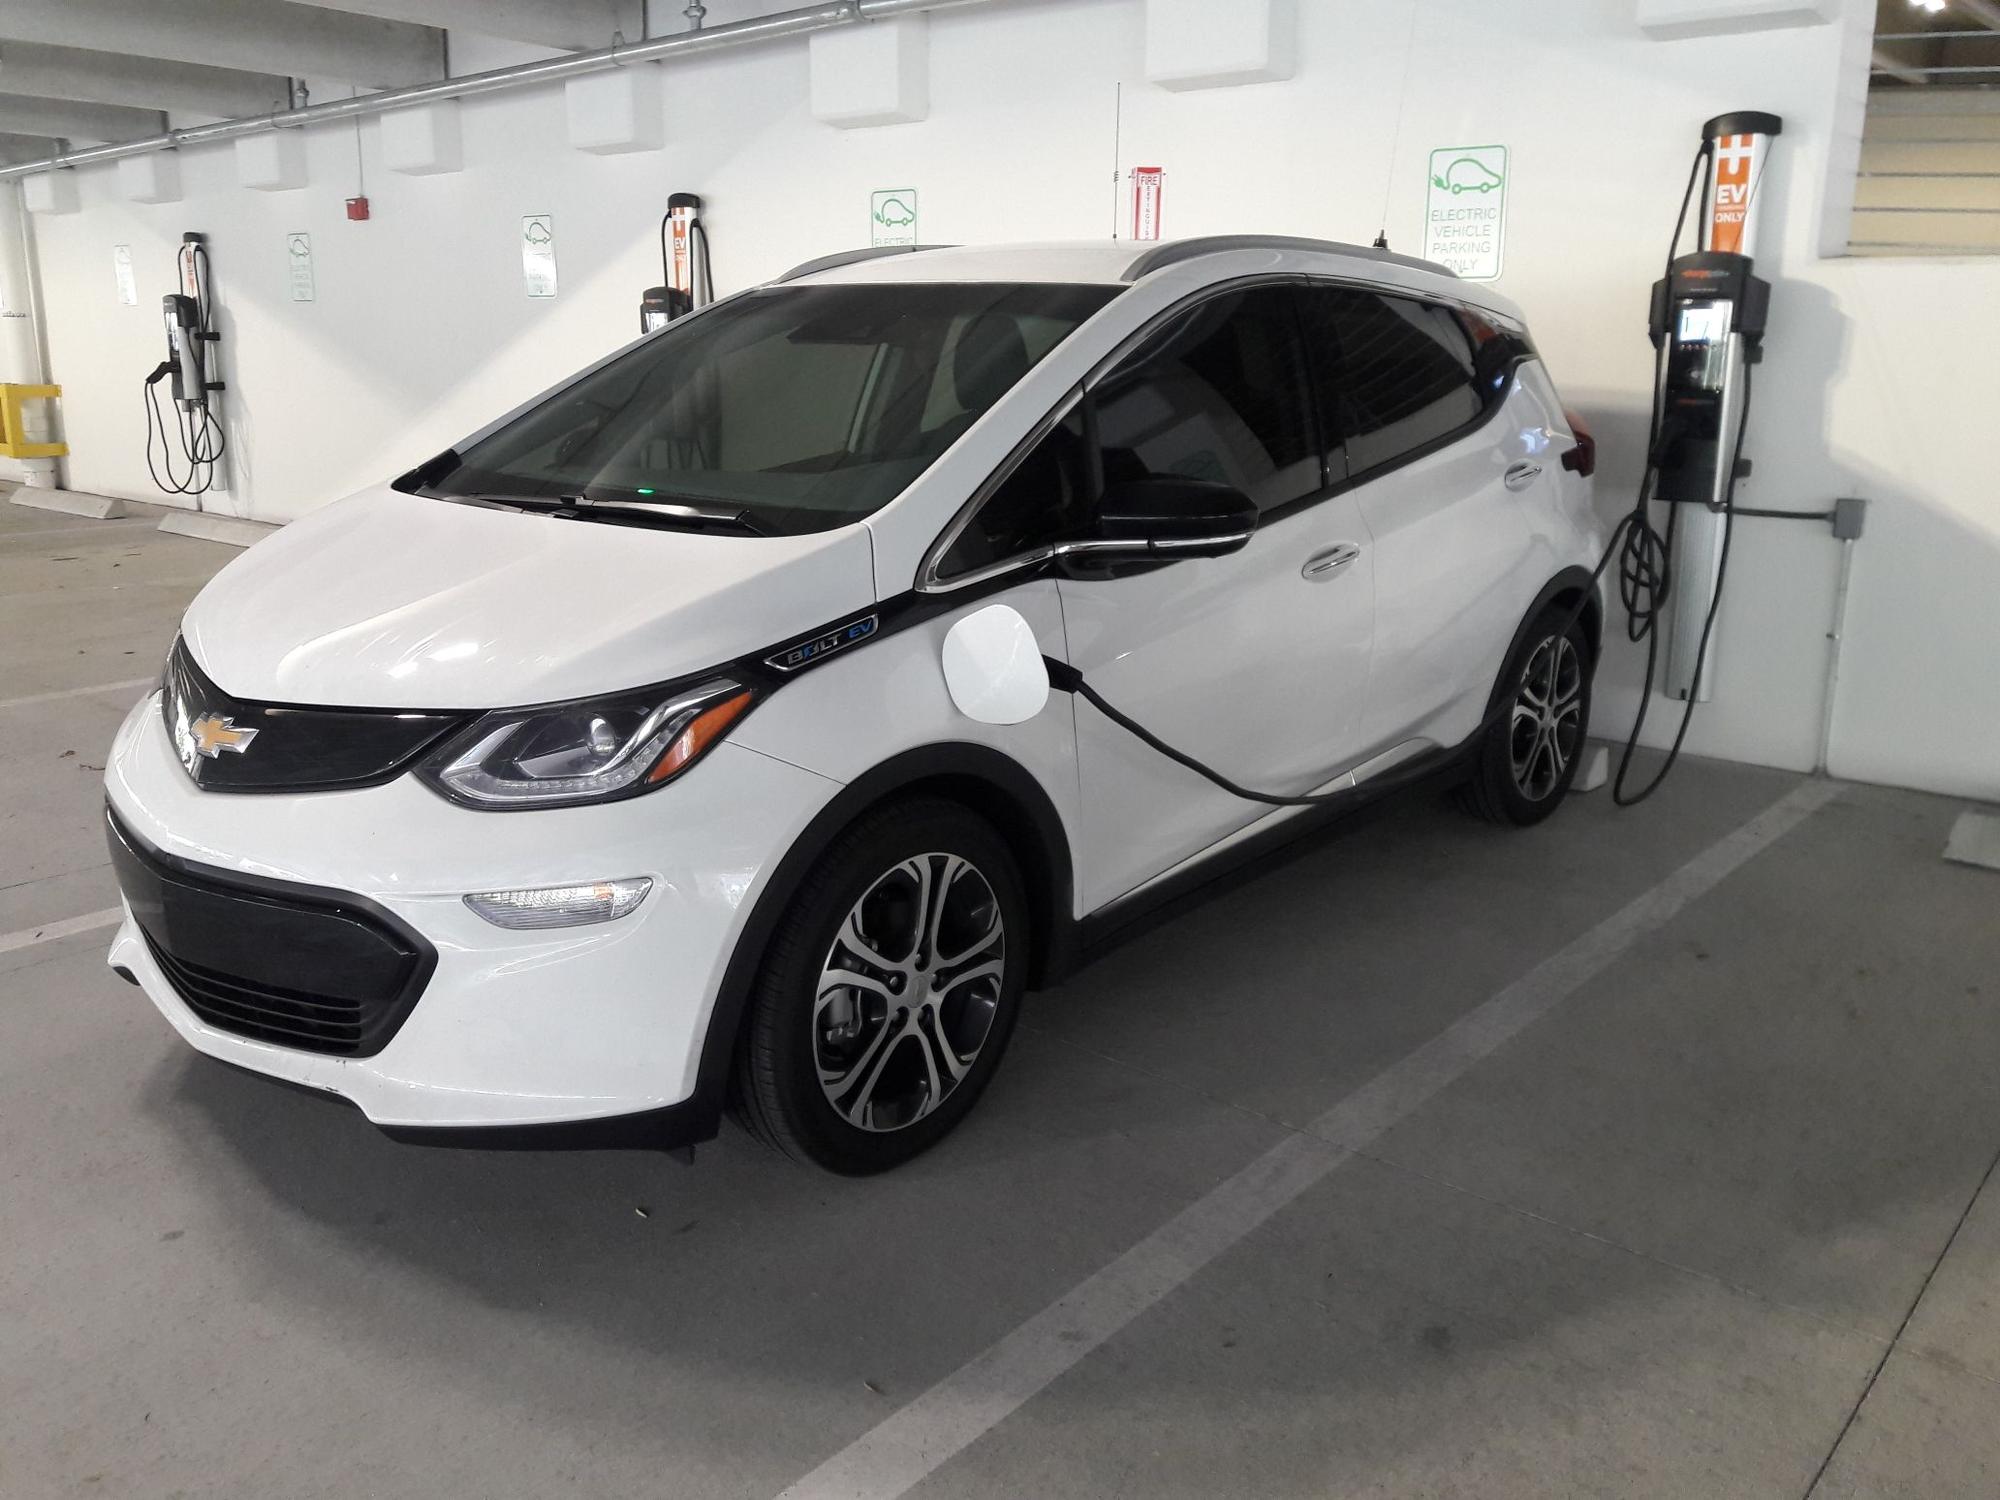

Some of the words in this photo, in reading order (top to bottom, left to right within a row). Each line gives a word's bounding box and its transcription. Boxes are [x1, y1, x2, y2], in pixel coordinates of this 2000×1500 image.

[1141, 175, 1158, 185] FIRE
[1717, 184, 1747, 204] EV
[1431, 207, 1497, 221] ELECTRIC
[1715, 211, 1745, 223] ONLY
[1434, 224, 1492, 238] VEHICLE
[674, 238, 685, 249] EV
[1432, 240, 1491, 254] PARKING
[1442, 258, 1479, 272] ONLY
[848, 620, 872, 638] EV
